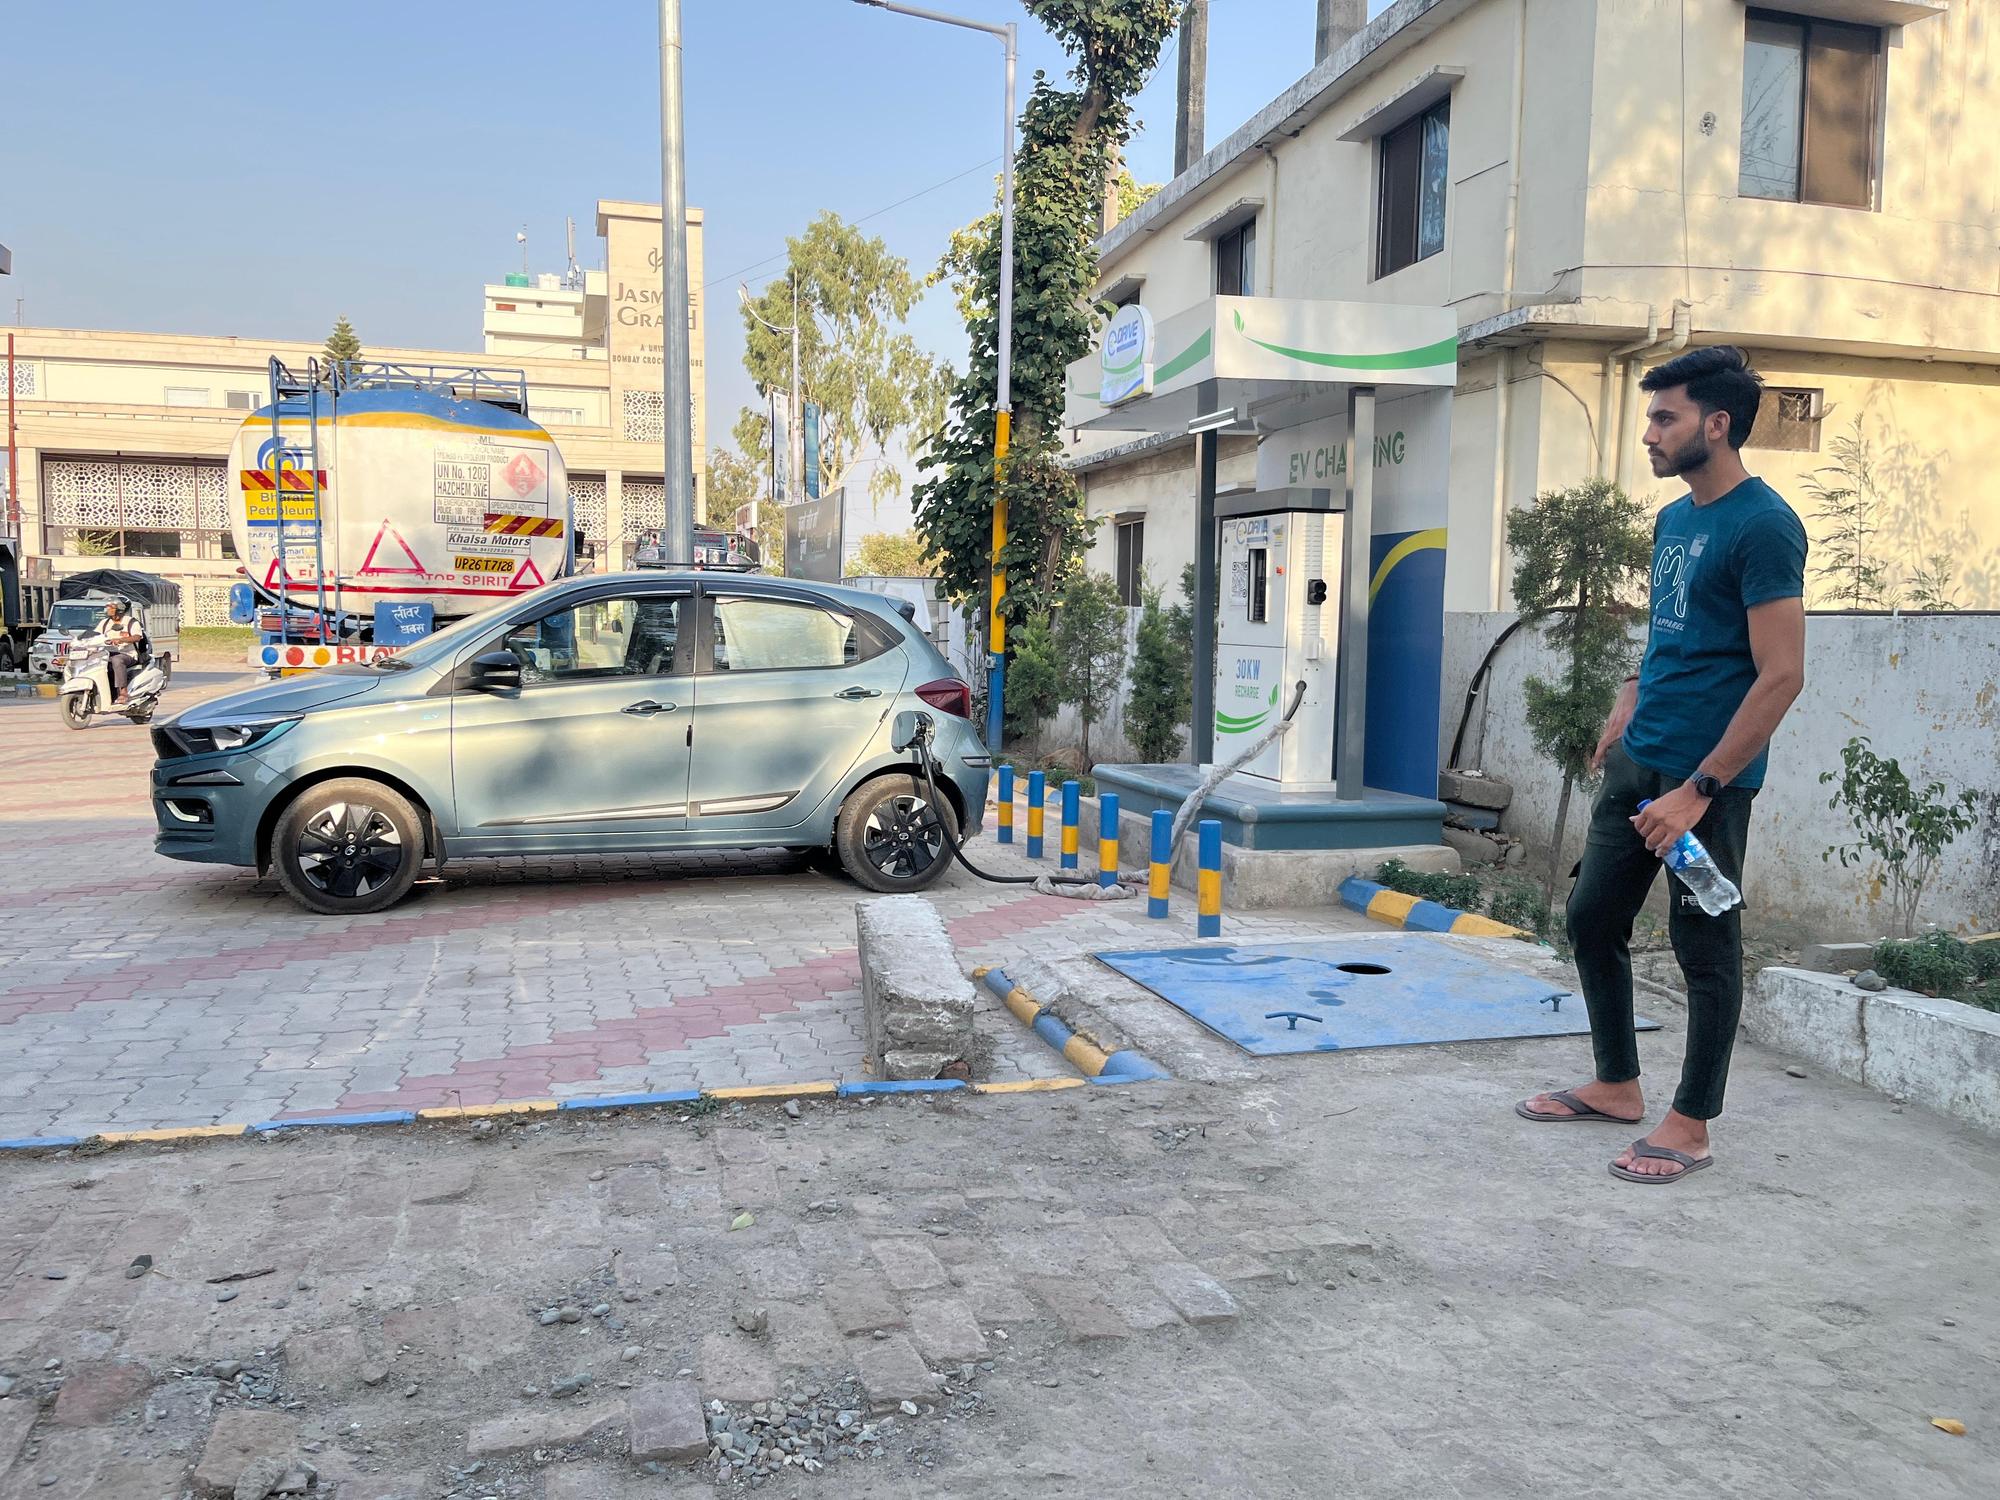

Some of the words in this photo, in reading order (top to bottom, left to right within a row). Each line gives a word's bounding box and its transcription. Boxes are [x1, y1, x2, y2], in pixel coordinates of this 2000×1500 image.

[615, 283, 698, 306] JASME
[612, 354, 640, 364] BOMBAY
[1289, 450, 1311, 484] EV
[1314, 431, 1405, 479] CHAING
[437, 463, 449, 478] UN
[451, 464, 464, 479] No.
[467, 466, 487, 480] 1203
[437, 480, 471, 496] HAZCHEM
[491, 502, 517, 510] SPECIALIST
[518, 503, 535, 511] ADVICE
[448, 532, 487, 545] Khalsa
[491, 535, 531, 546] Motors
[462, 575, 509, 587] SPIRIT
[1657, 617, 1686, 632] APPAREL
[1236, 658, 1260, 680] 30KW
